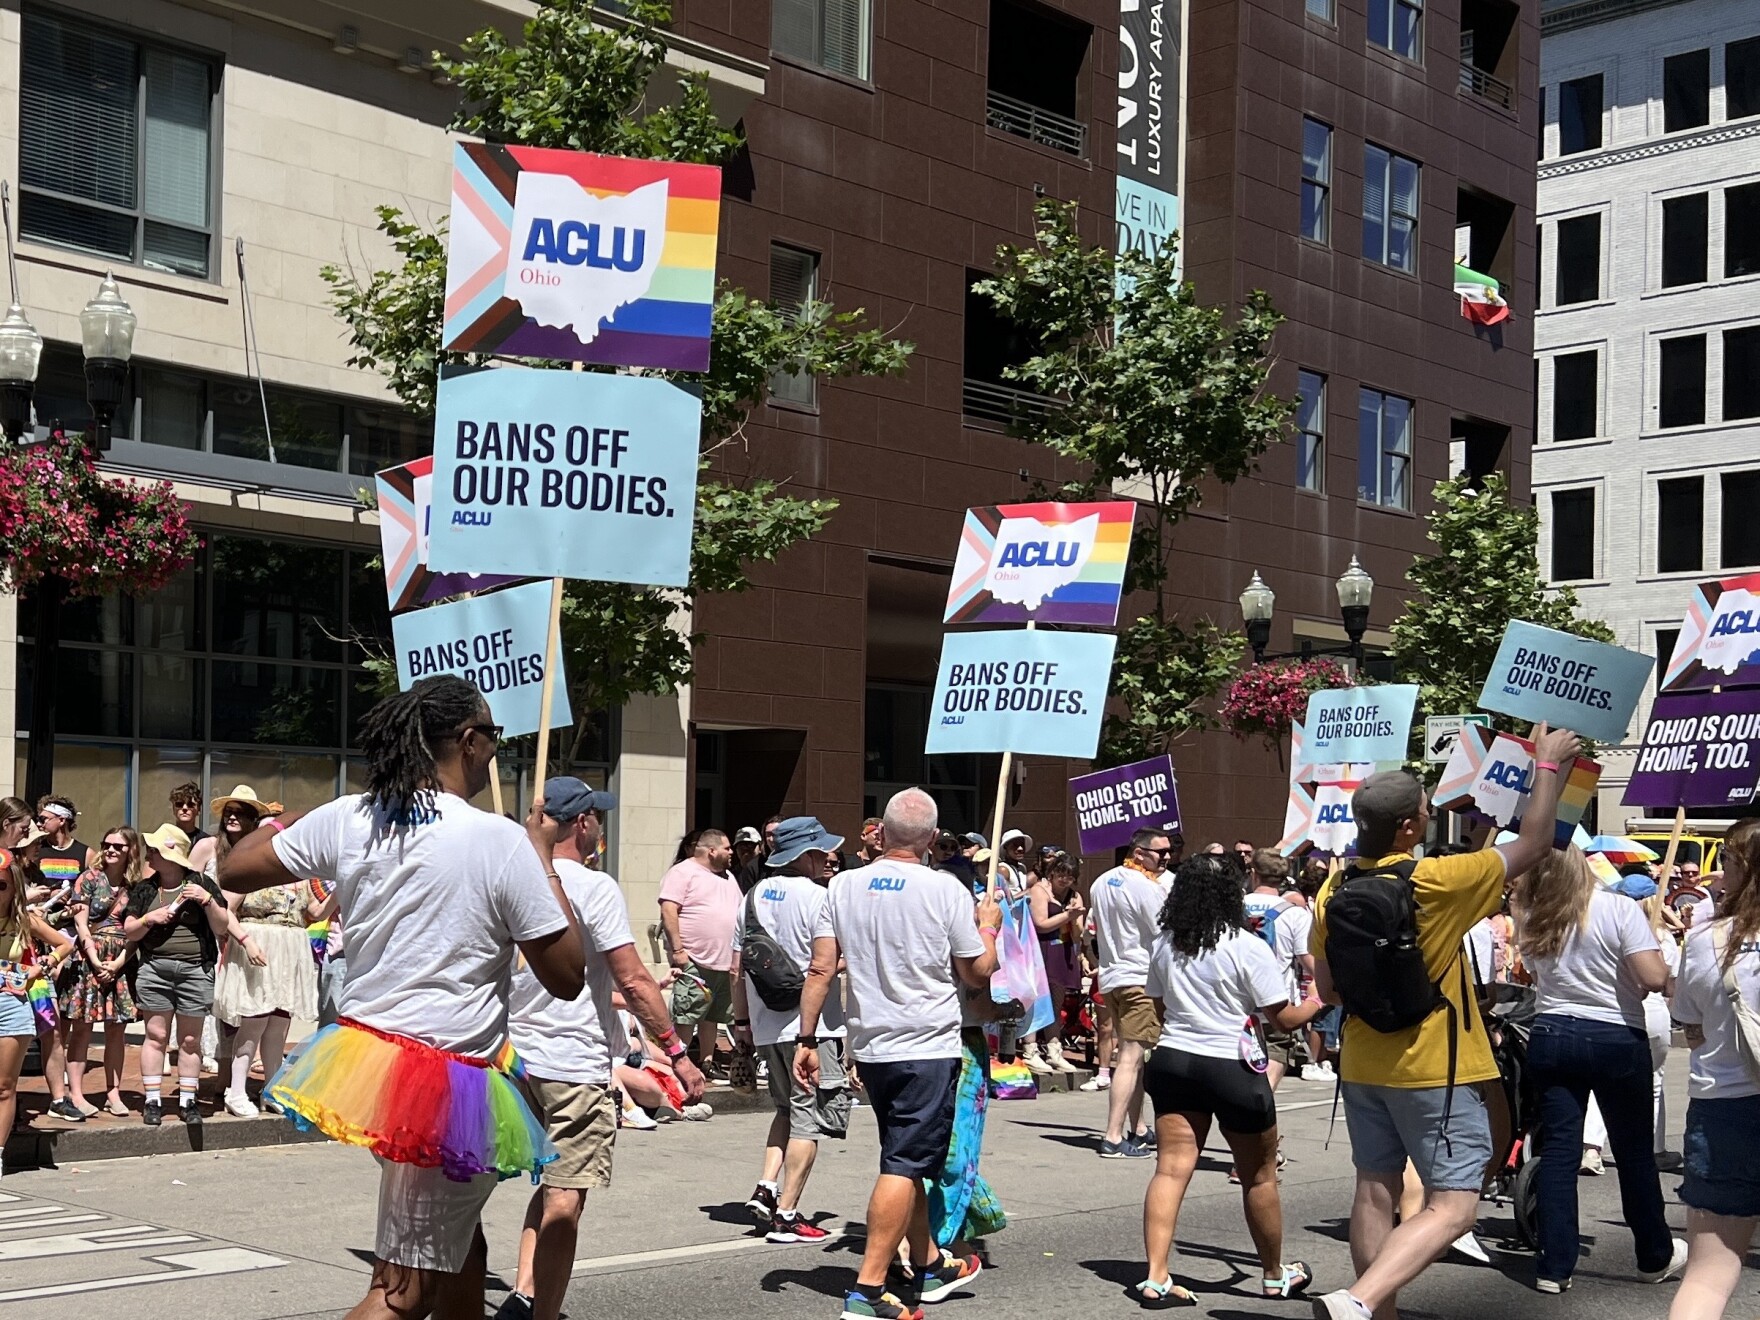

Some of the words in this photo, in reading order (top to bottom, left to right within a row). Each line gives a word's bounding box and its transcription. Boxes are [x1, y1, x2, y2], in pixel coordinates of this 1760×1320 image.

[1150, 0, 1164, 60] APA
[1148, 62, 1163, 175] LUXURY
[1116, 189, 1141, 222] VE
[1148, 200, 1166, 230] IN
[522, 217, 646, 273] ACLU
[1116, 221, 1168, 267] DAY
[520, 268, 561, 286] Ohio
[456, 420, 556, 464] BANS
[565, 425, 630, 468] OFF
[453, 464, 529, 507] OUR
[540, 468, 674, 518] BODIES.
[451, 510, 491, 526] ACLU
[997, 541, 1081, 568] ACLU
[994, 571, 1020, 581] Ohio
[1709, 609, 1760, 638] ACL
[407, 639, 469, 677] BANS
[473, 628, 514, 663] OFF
[1513, 647, 1561, 674] BANS
[1561, 660, 1598, 683] OFF
[948, 661, 1009, 687] BANS
[1012, 661, 1059, 686] OFF
[1507, 666, 1543, 691] OUR
[1543, 679, 1613, 711] BODIES.
[943, 688, 990, 713] OUR
[995, 687, 1088, 715] BODIES.
[1502, 685, 1522, 696] ACLU
[941, 716, 965, 725] ACLU
[1319, 706, 1352, 723] BANS
[1354, 705, 1380, 721] OFF
[1316, 723, 1342, 739] OUR
[1344, 720, 1394, 738] BODIES.
[1647, 719, 1697, 746] OHIO
[1697, 715, 1720, 741] IS
[1637, 744, 1698, 774] HOME,
[1704, 742, 1751, 769] TOO.
[1076, 786, 1115, 812] OHIO
[1115, 781, 1133, 801] IS
[1133, 773, 1168, 797] OUR
[1479, 782, 1500, 797] Ohio
[1483, 760, 1532, 796] ACL
[1728, 787, 1752, 798] ACLU
[1080, 803, 1130, 830] HOME,
[1129, 794, 1168, 818] TOO.
[1316, 803, 1353, 825] ACL
[761, 888, 787, 902] ACLU
[867, 877, 906, 891] ACLU
